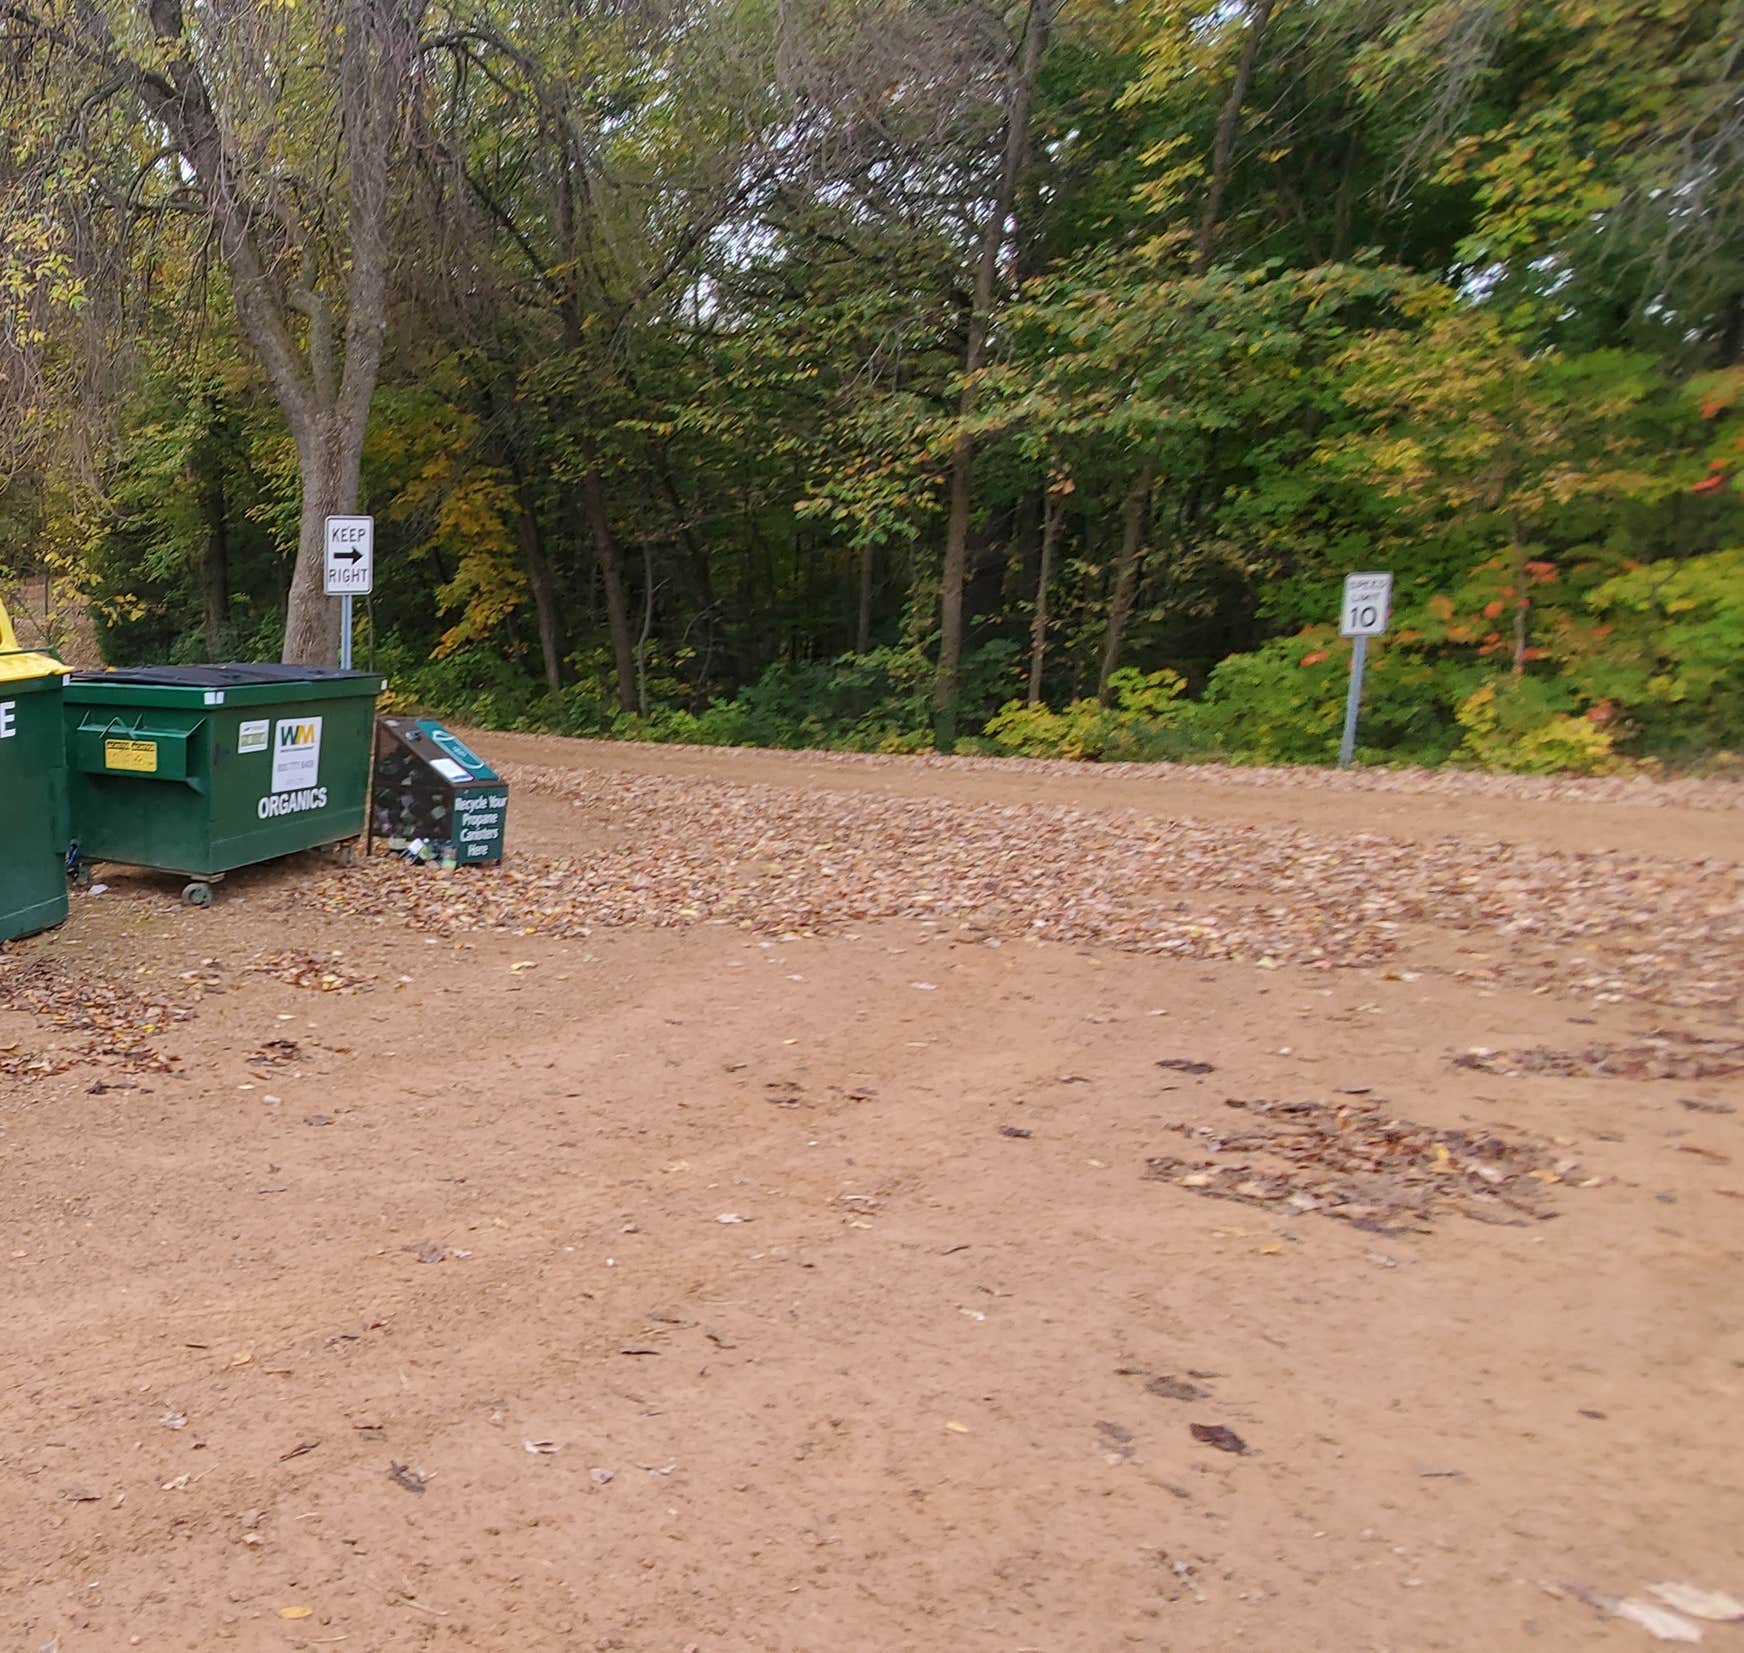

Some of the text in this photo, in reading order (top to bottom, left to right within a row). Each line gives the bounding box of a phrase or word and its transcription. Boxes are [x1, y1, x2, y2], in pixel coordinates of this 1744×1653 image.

[332, 527, 366, 543] KEEP
[328, 568, 368, 584] RIGHT
[1350, 605, 1377, 628] 10
[280, 723, 315, 747] WM
[258, 787, 327, 819] ORGANICS
[454, 795, 508, 813] Recycle Your
[462, 812, 498, 828] Propane
[460, 826, 499, 841] Canisters
[467, 843, 489, 857] Here
